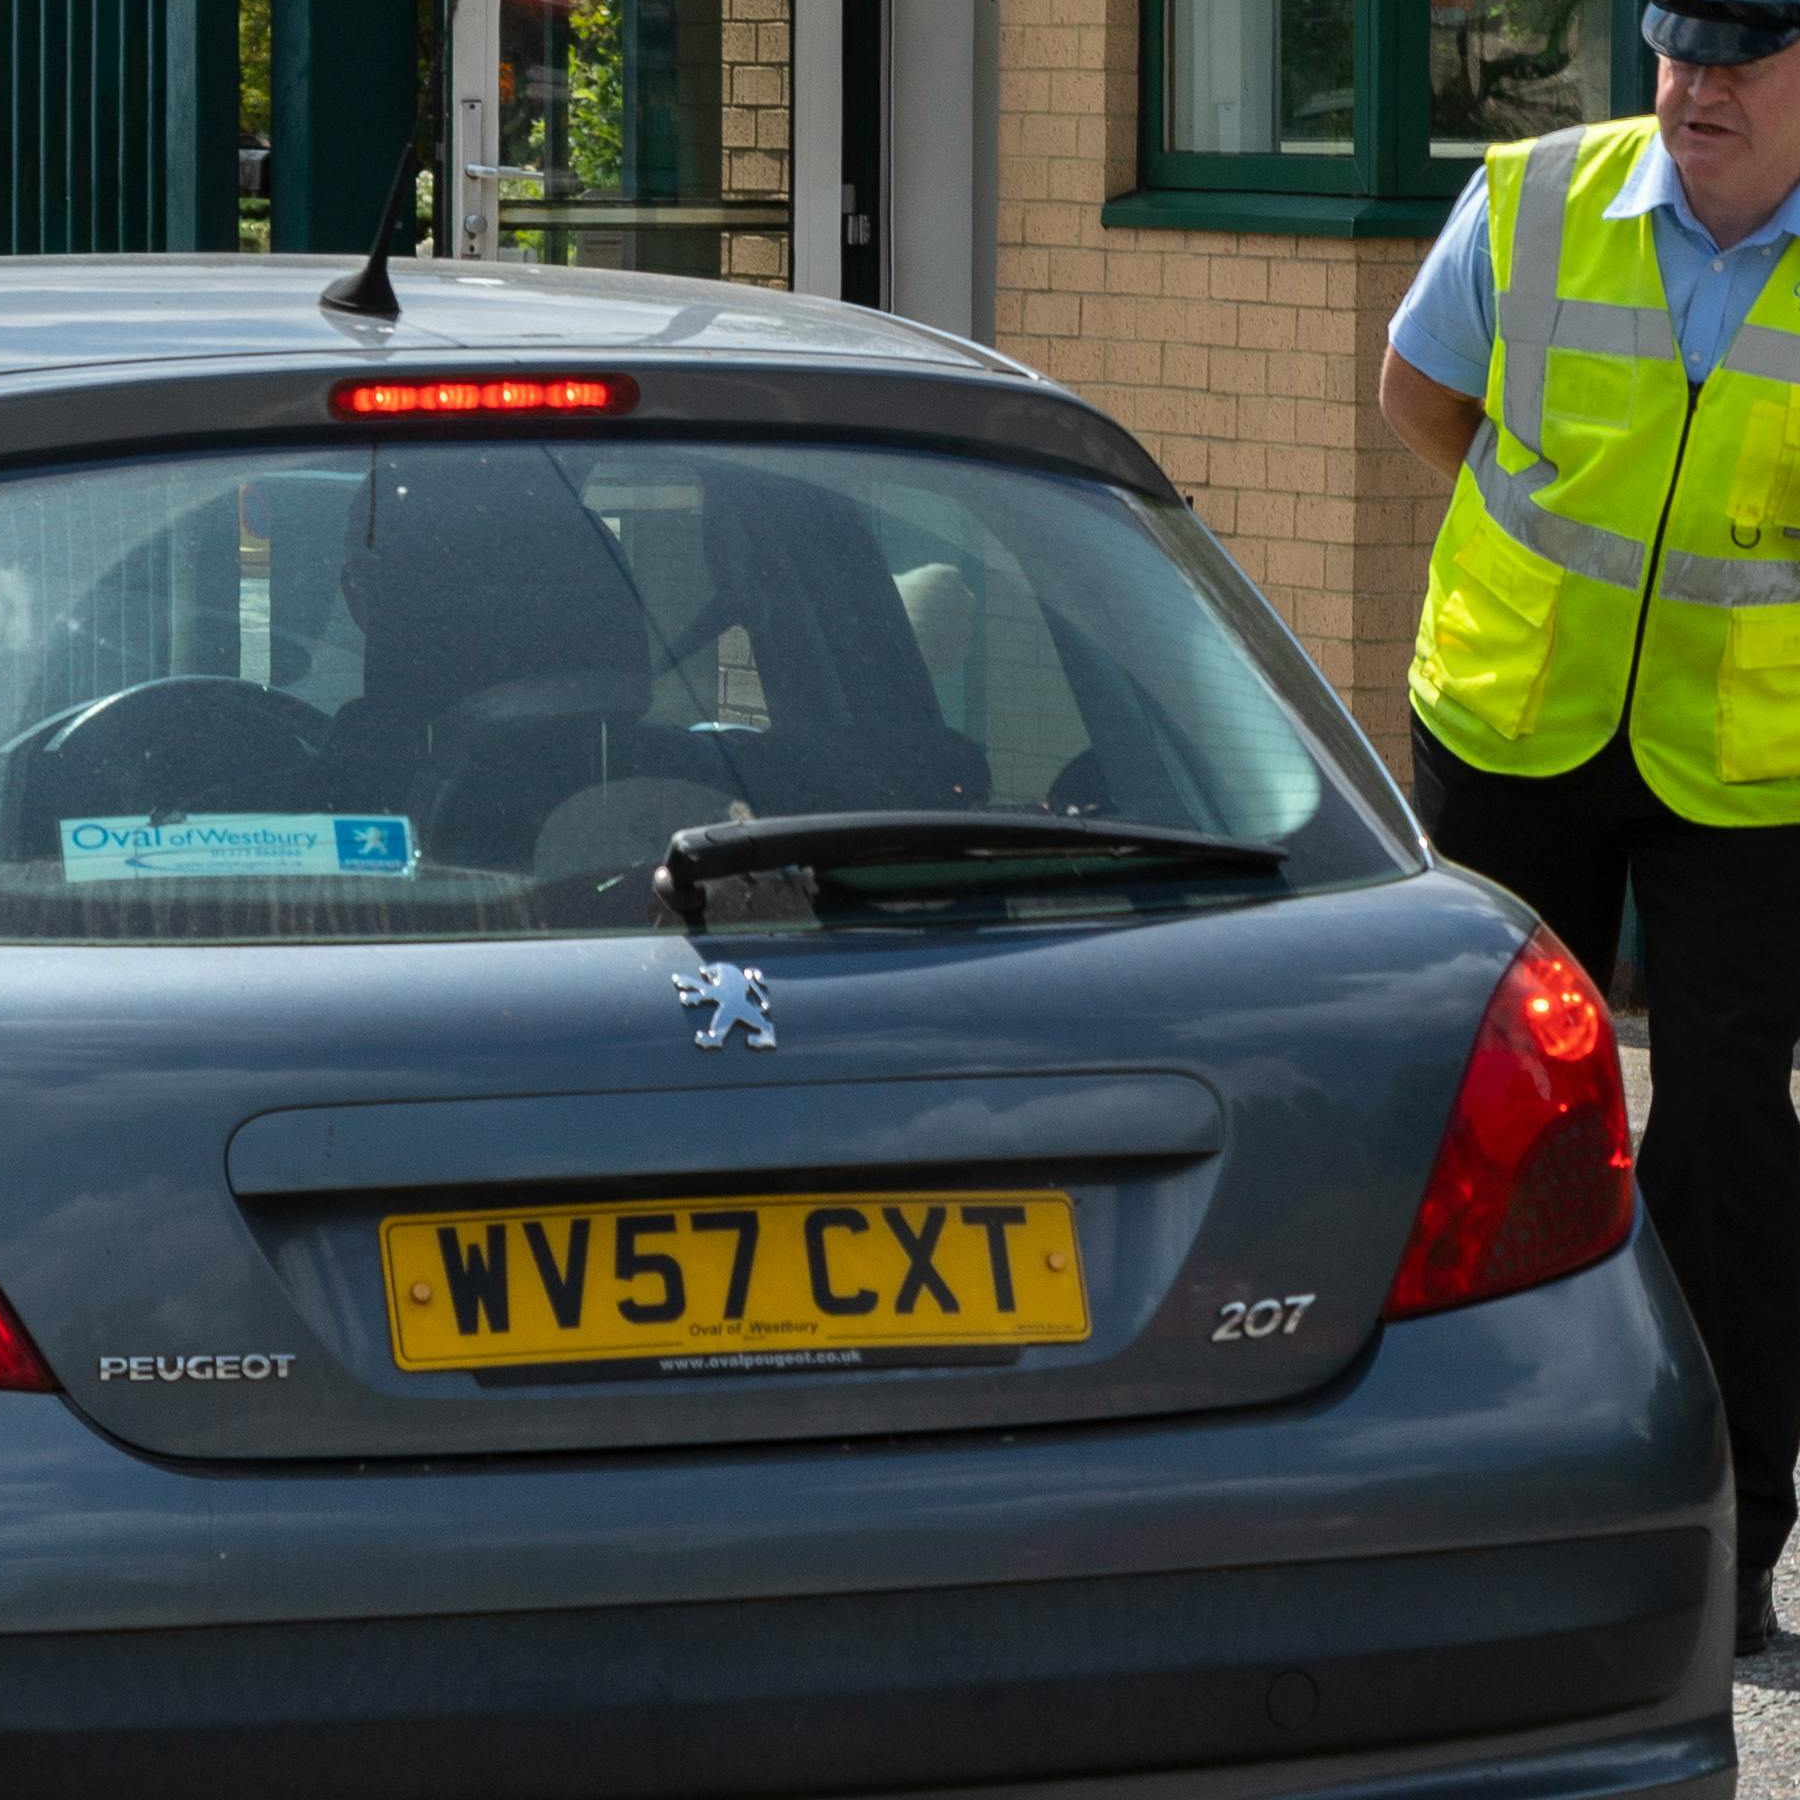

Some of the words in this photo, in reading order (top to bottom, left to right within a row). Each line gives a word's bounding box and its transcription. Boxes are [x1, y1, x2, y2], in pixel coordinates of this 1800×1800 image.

[72, 823, 161, 850] Oval
[169, 829, 194, 847] of
[194, 828, 318, 849] Westbury
[436, 1210, 759, 1336] WV57
[804, 1204, 1027, 1317] CXT
[689, 1323, 722, 1337] Oval
[727, 1322, 742, 1336] of
[748, 1321, 819, 1335] Westbury
[1212, 1294, 1316, 1342] 207
[100, 1354, 296, 1381] PEUGEOT
[660, 1350, 863, 1371] www.ovalpeugeot.co.uk
